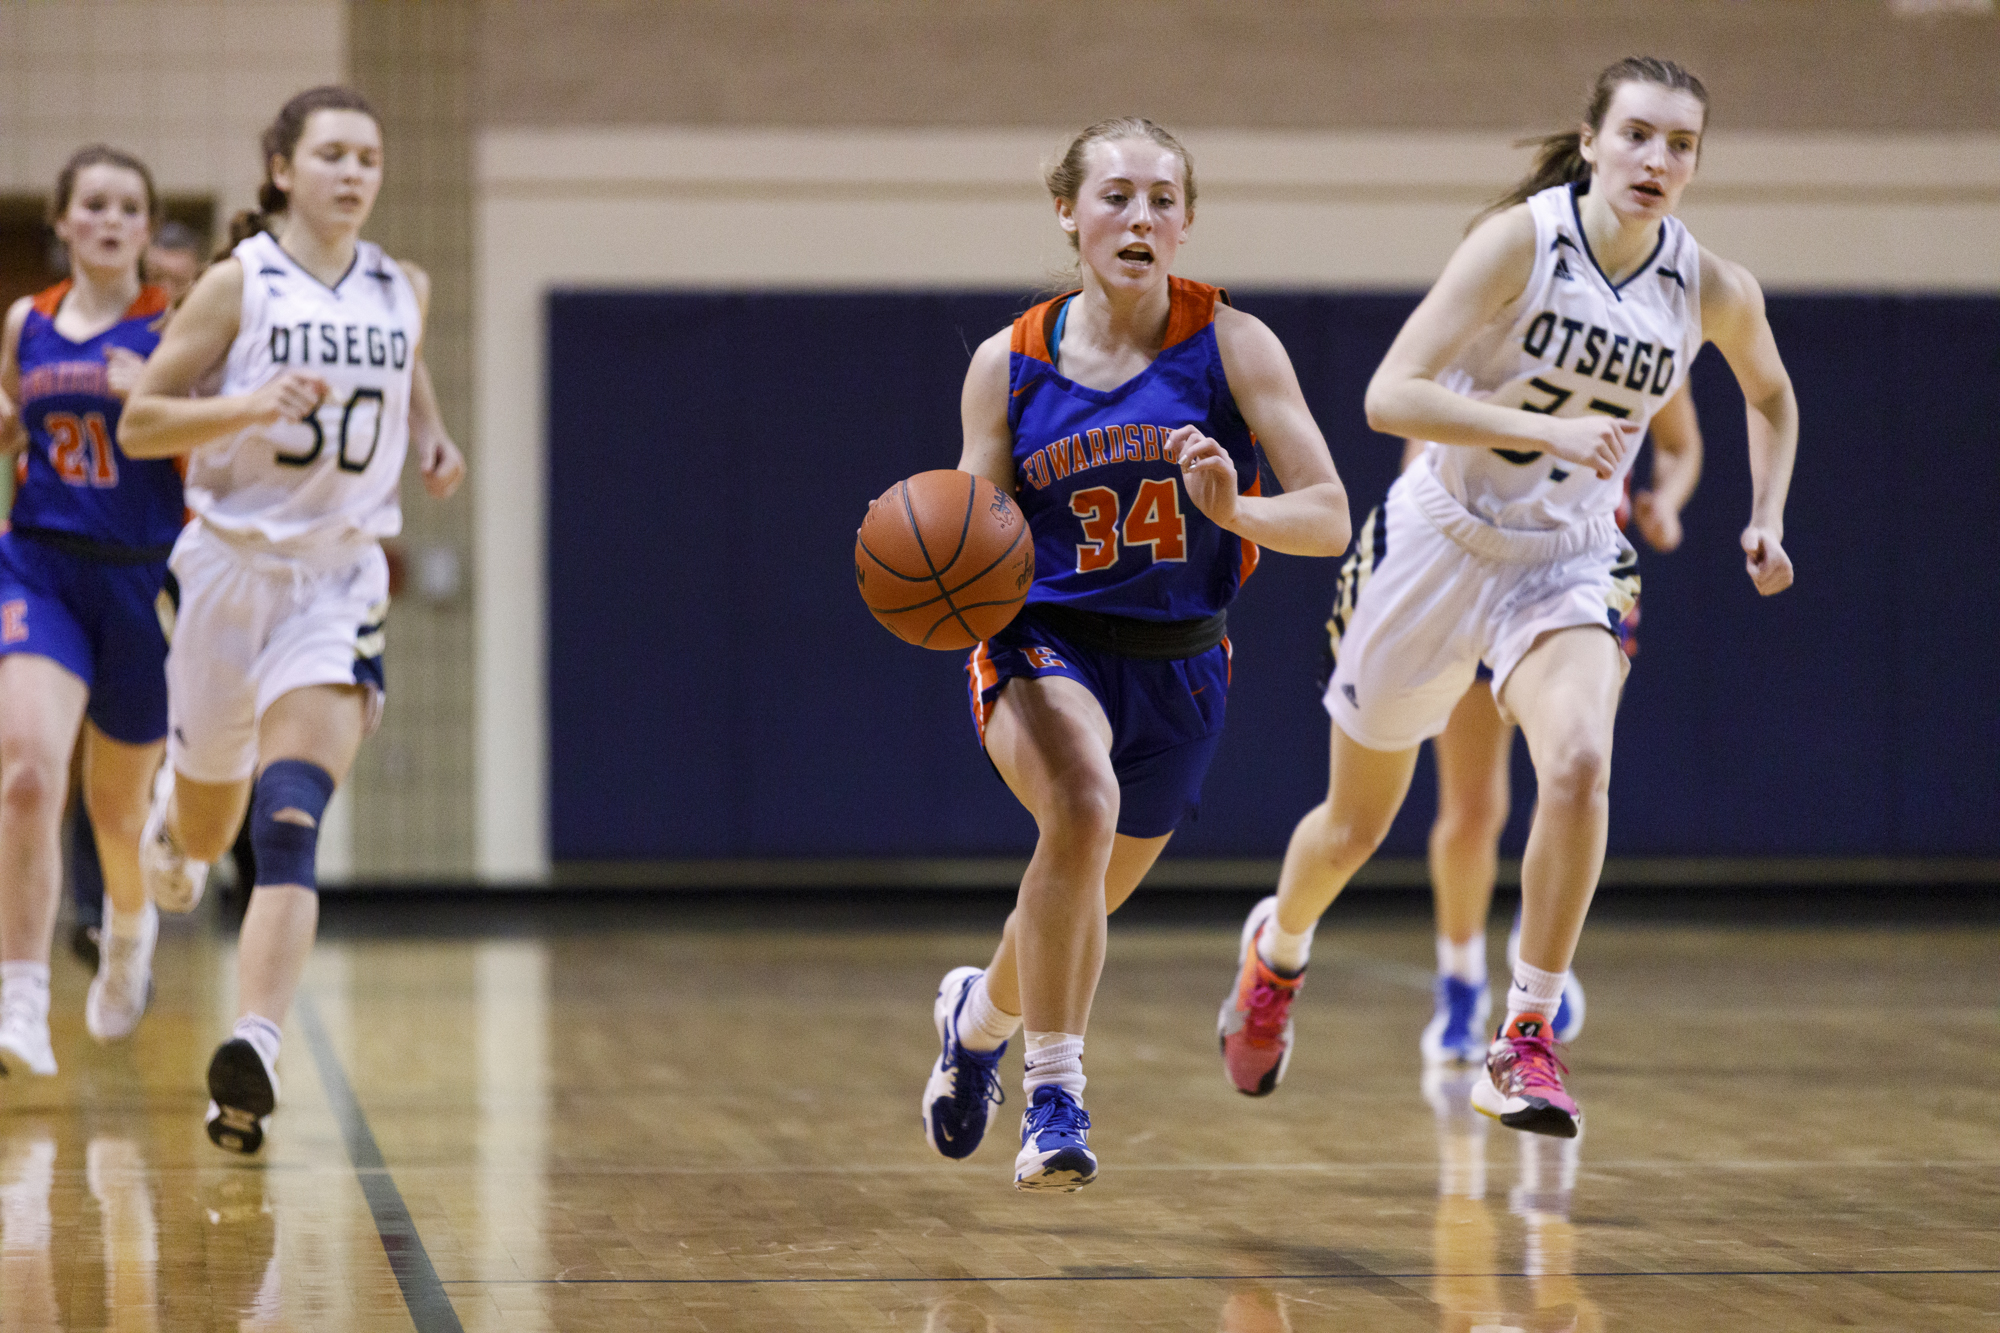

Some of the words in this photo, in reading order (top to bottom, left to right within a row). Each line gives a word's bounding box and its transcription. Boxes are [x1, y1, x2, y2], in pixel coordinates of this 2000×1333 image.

[270, 322, 407, 371] OTSEGO
[1523, 311, 1676, 396] OTSEGO
[44, 412, 119, 488] 21
[274, 386, 384, 474] 30
[1023, 424, 1183, 490] EDWARDSBU
[1069, 477, 1187, 574] 34
[1, 598, 30, 646] E
[1018, 646, 1067, 669] E
